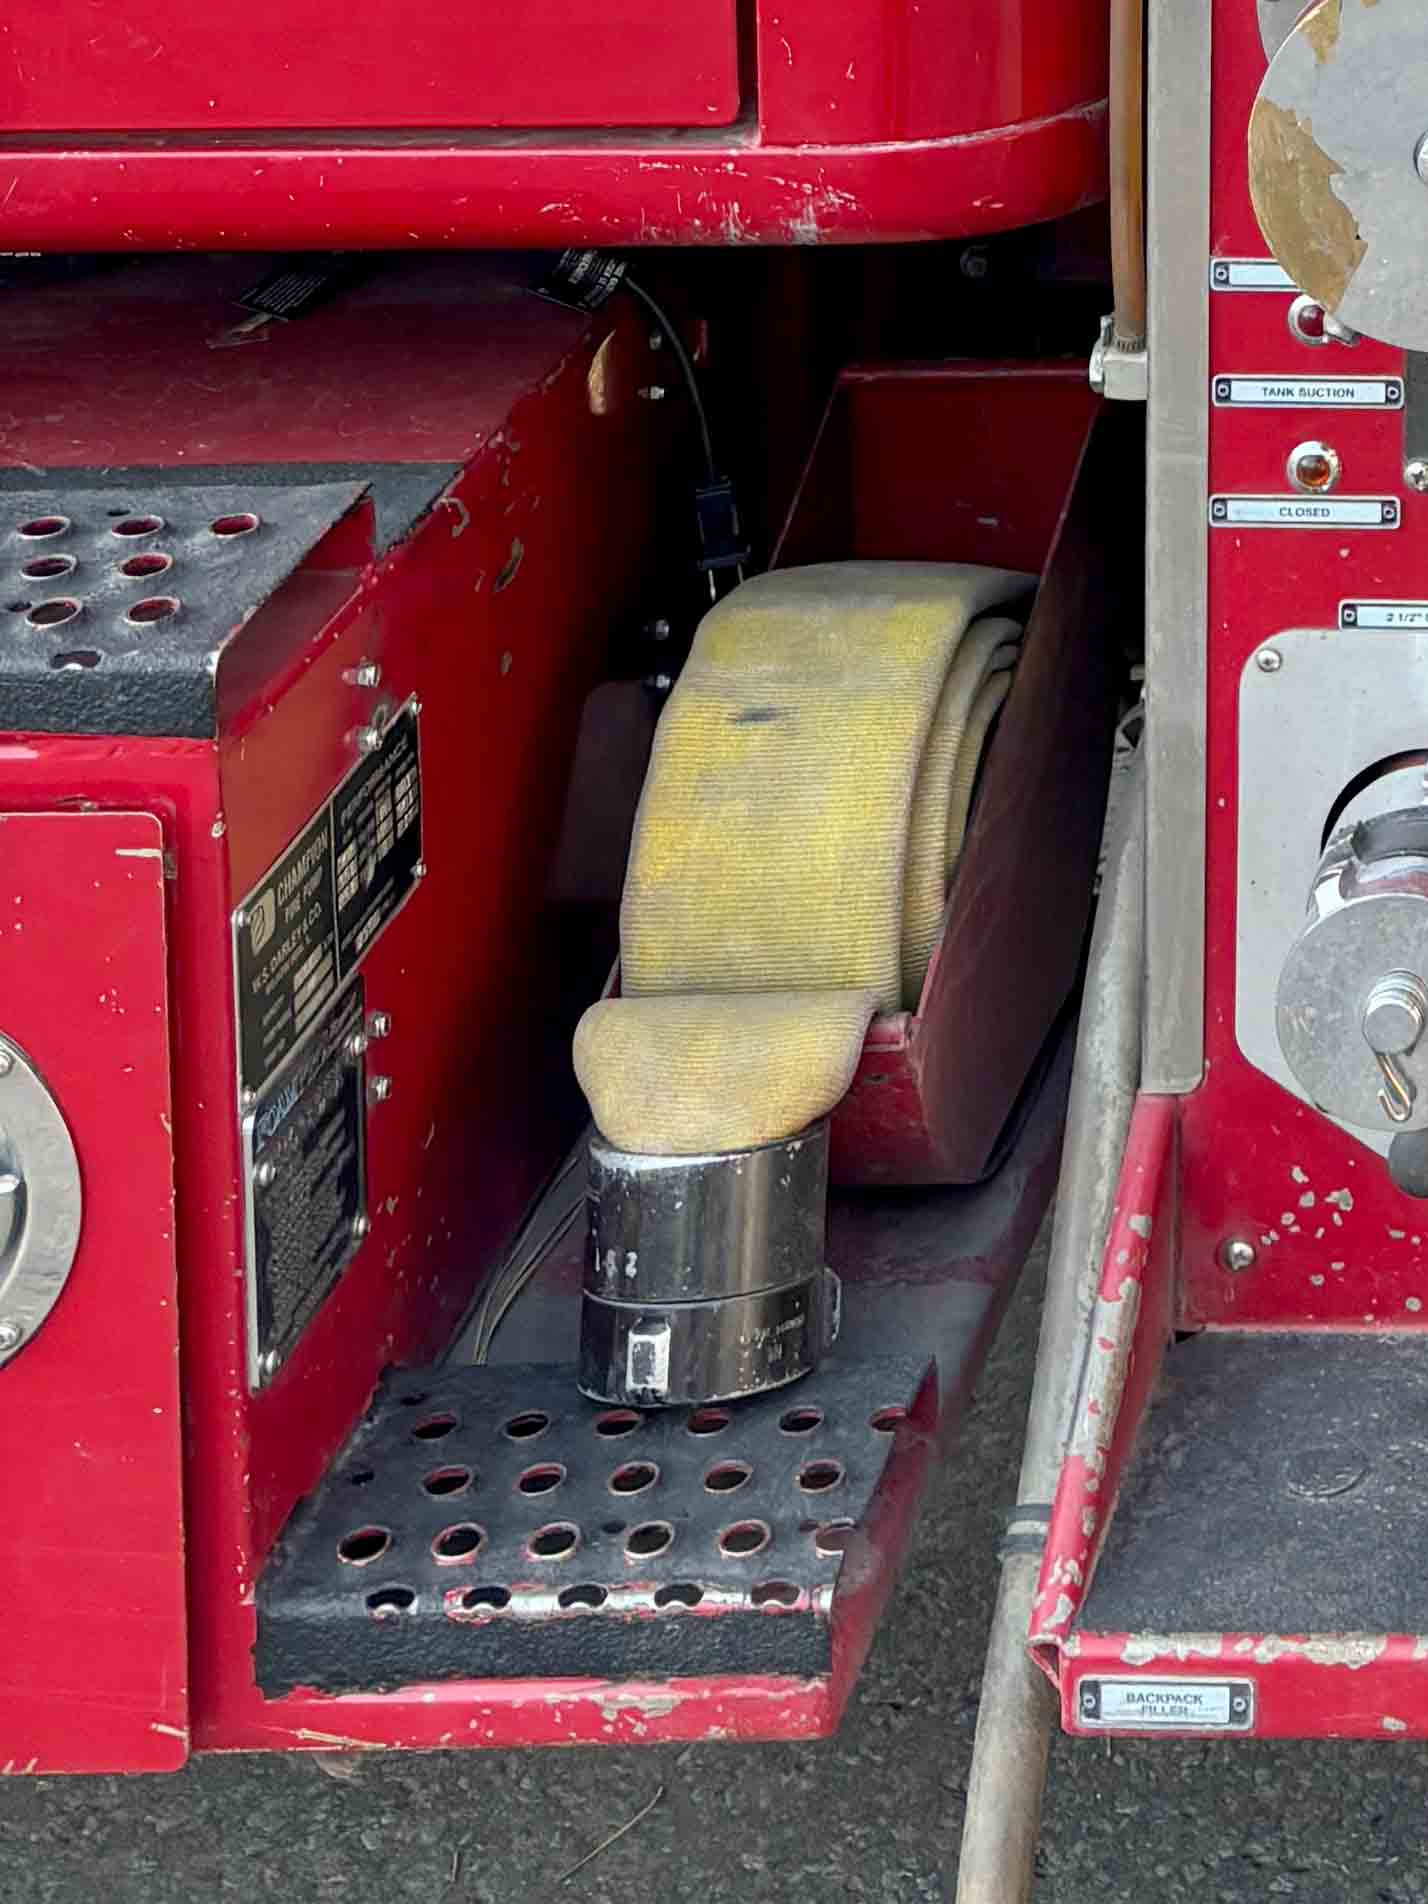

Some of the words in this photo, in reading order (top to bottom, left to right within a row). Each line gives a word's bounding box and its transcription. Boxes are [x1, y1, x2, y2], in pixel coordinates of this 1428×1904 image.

[1262, 386, 1295, 397] TANK
[1301, 386, 1355, 398] SUCTION
[1279, 506, 1330, 518] CLOSED
[1126, 1693, 1203, 1705] BACKPACK
